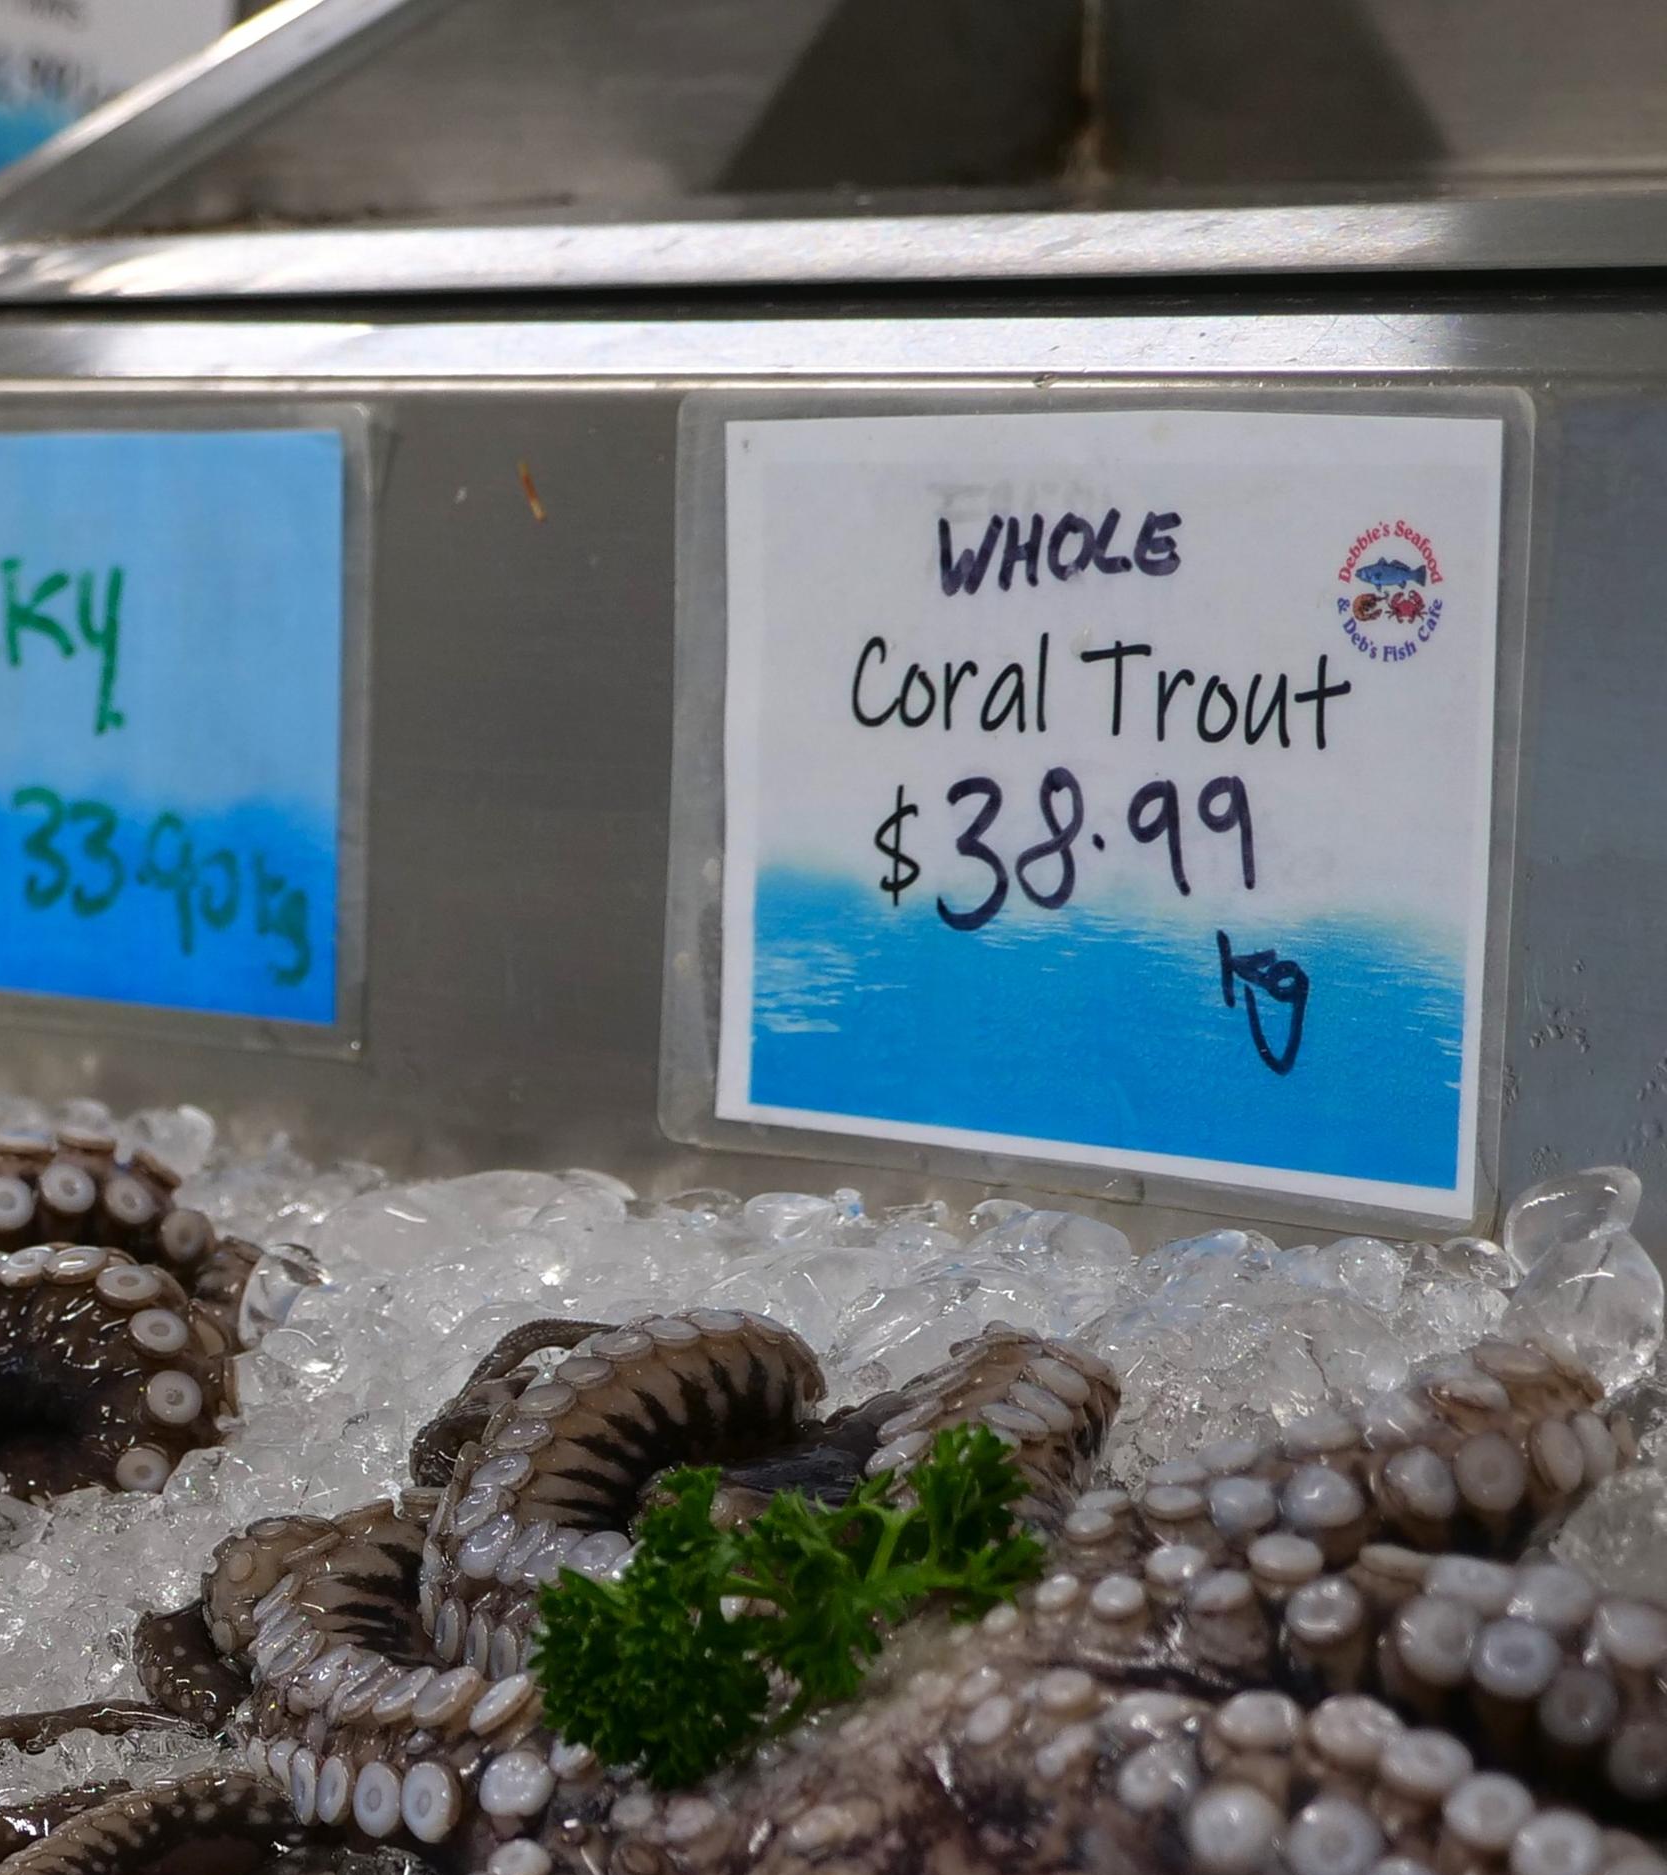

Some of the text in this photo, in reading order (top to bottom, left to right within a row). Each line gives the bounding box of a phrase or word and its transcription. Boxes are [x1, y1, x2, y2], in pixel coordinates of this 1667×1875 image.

[938, 507, 1183, 597] WHOLE
[1338, 519, 1443, 585] Debbie's Seafood
[1336, 597, 1443, 663] & Deb's Fish Cafe
[852, 632, 1352, 750] Coral Trout
[874, 766, 1255, 931] $38.99
